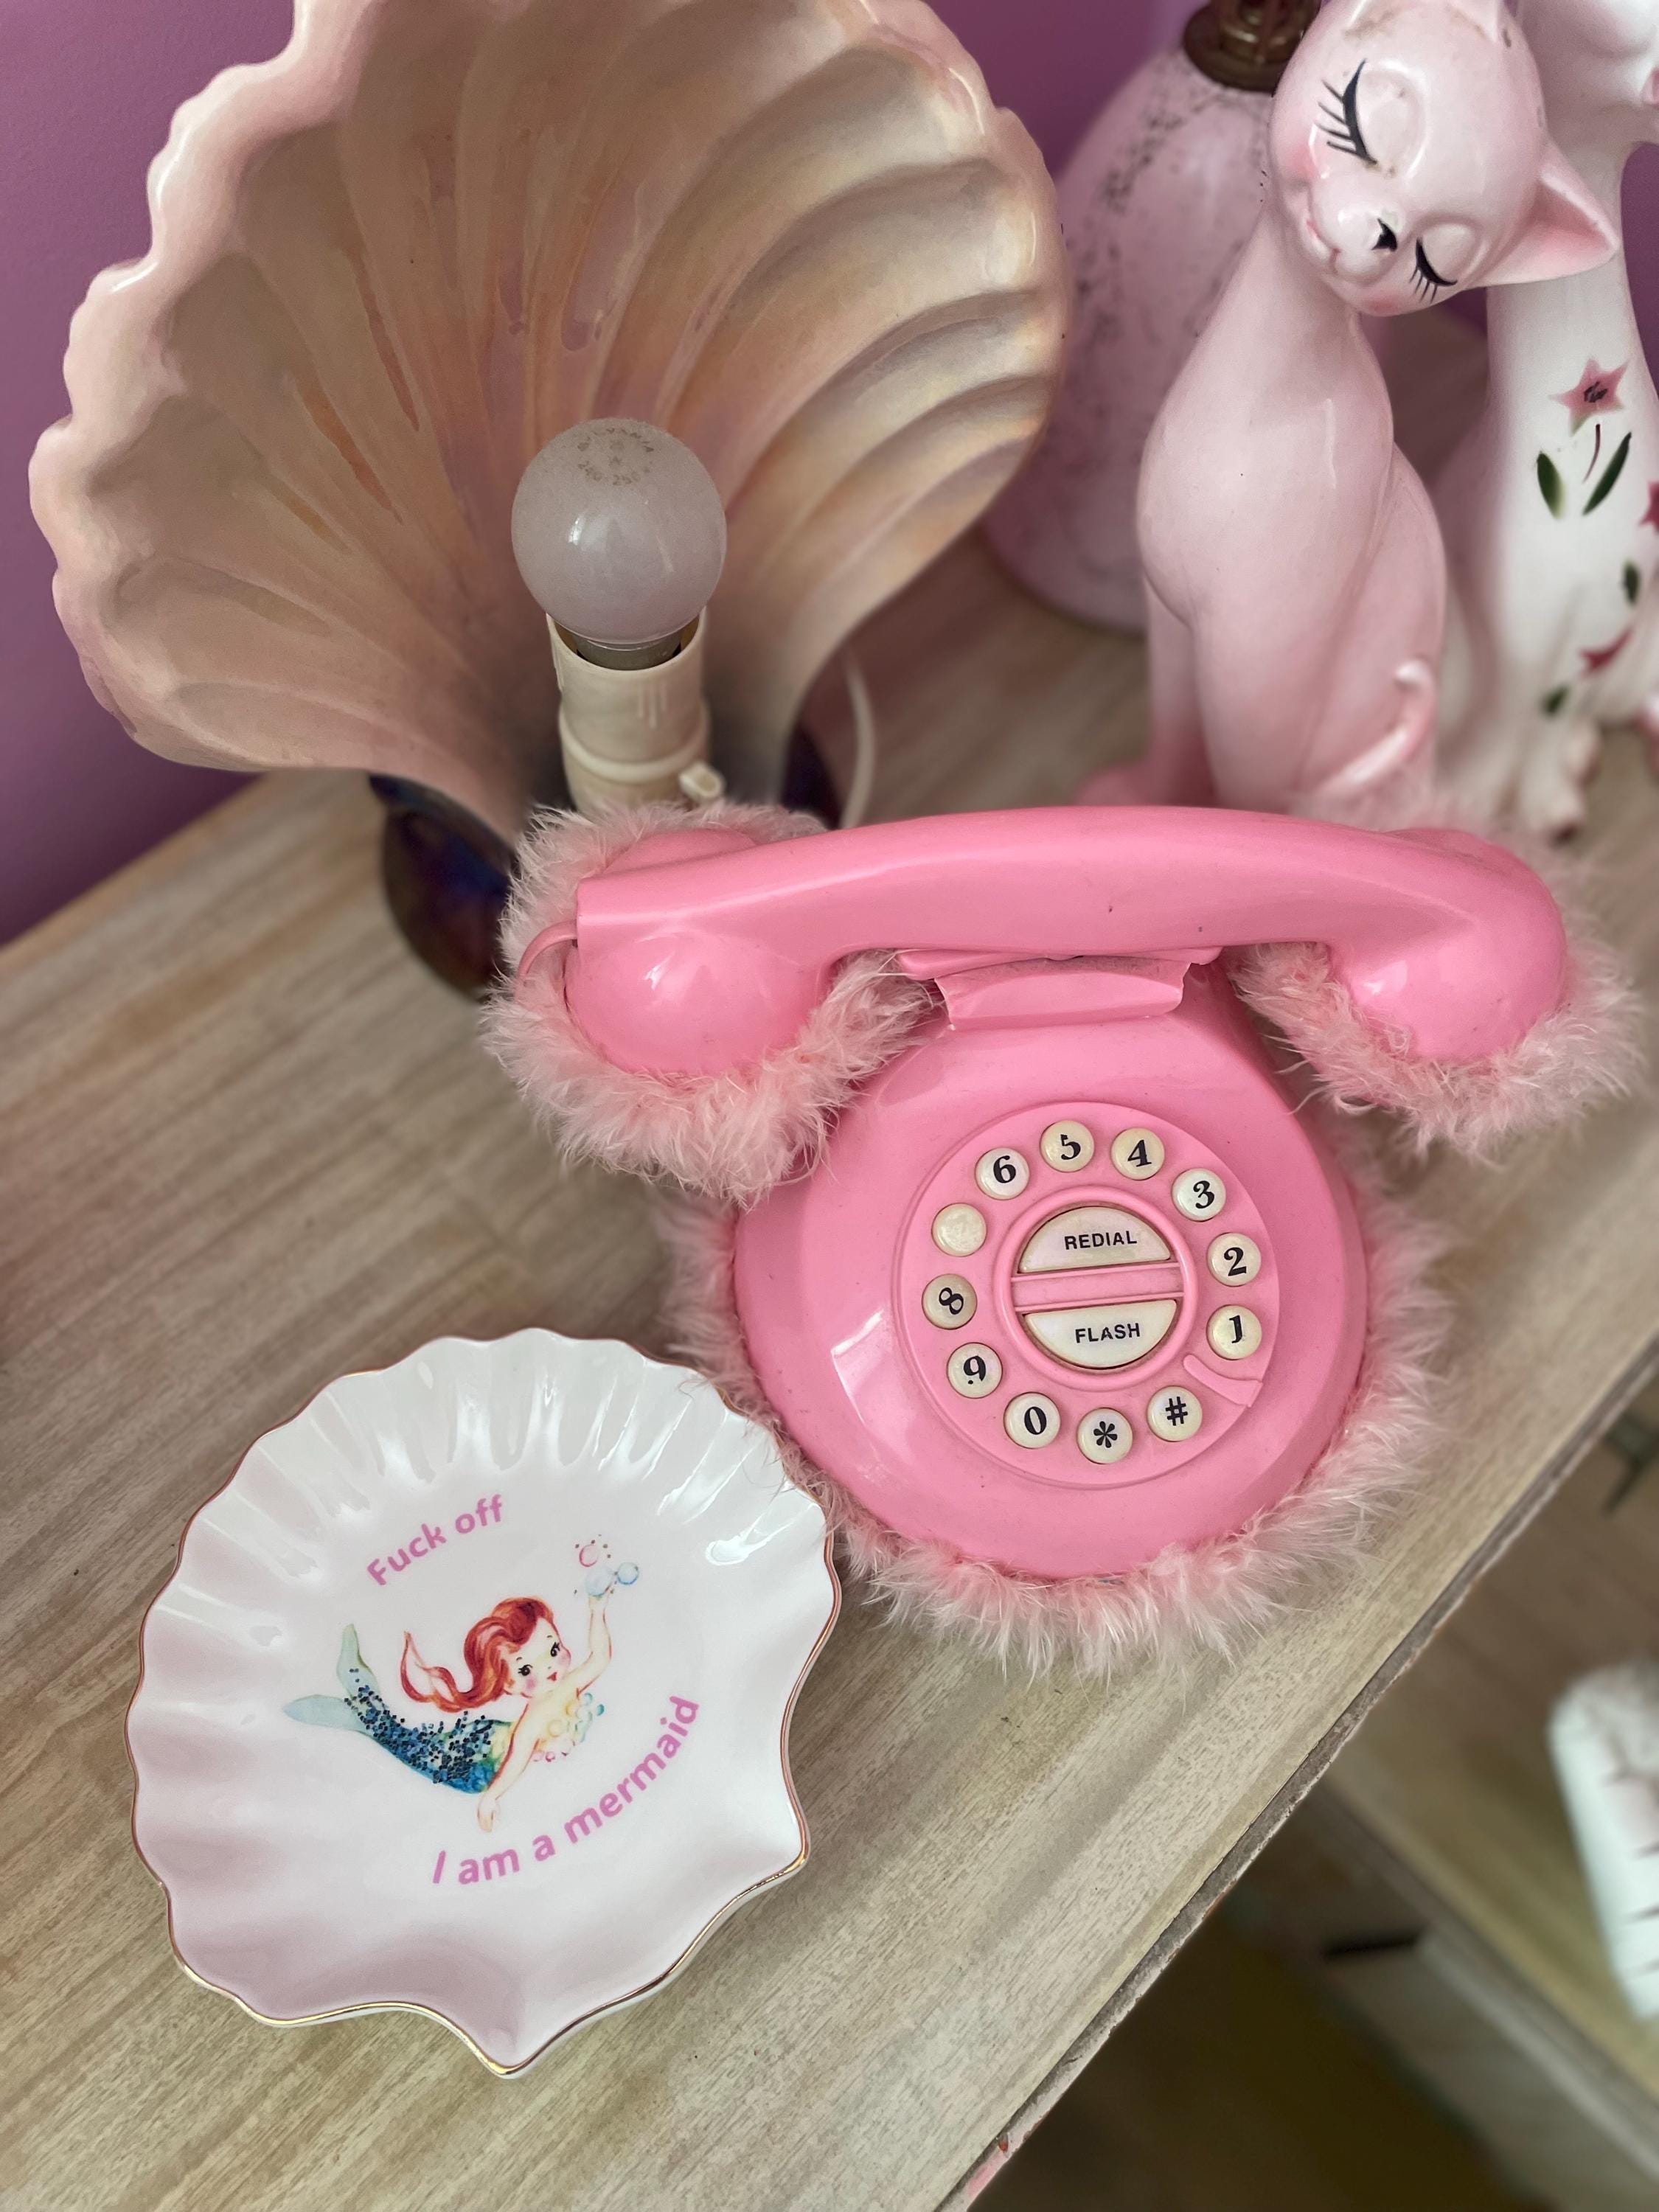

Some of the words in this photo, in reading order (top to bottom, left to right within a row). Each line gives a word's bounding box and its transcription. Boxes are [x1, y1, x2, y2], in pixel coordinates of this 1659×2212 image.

[1060, 1134, 1082, 1161] 5
[1127, 1139, 1152, 1167] 4
[992, 1155, 1017, 1183] 6
[1193, 1180, 1216, 1209] 3
[1064, 1230, 1138, 1251] REDIAL
[1223, 1247, 1248, 1277] 2
[938, 1287, 964, 1315] 8
[1075, 1322, 1141, 1343] FLASH
[1023, 1406, 1047, 1436] 0
[366, 1524, 446, 1585] Fuck
[455, 1495, 503, 1534] off
[432, 1851, 446, 1884] I
[458, 1848, 520, 1885] am
[532, 1834, 555, 1862] a
[564, 1695, 700, 1843] mermaid
